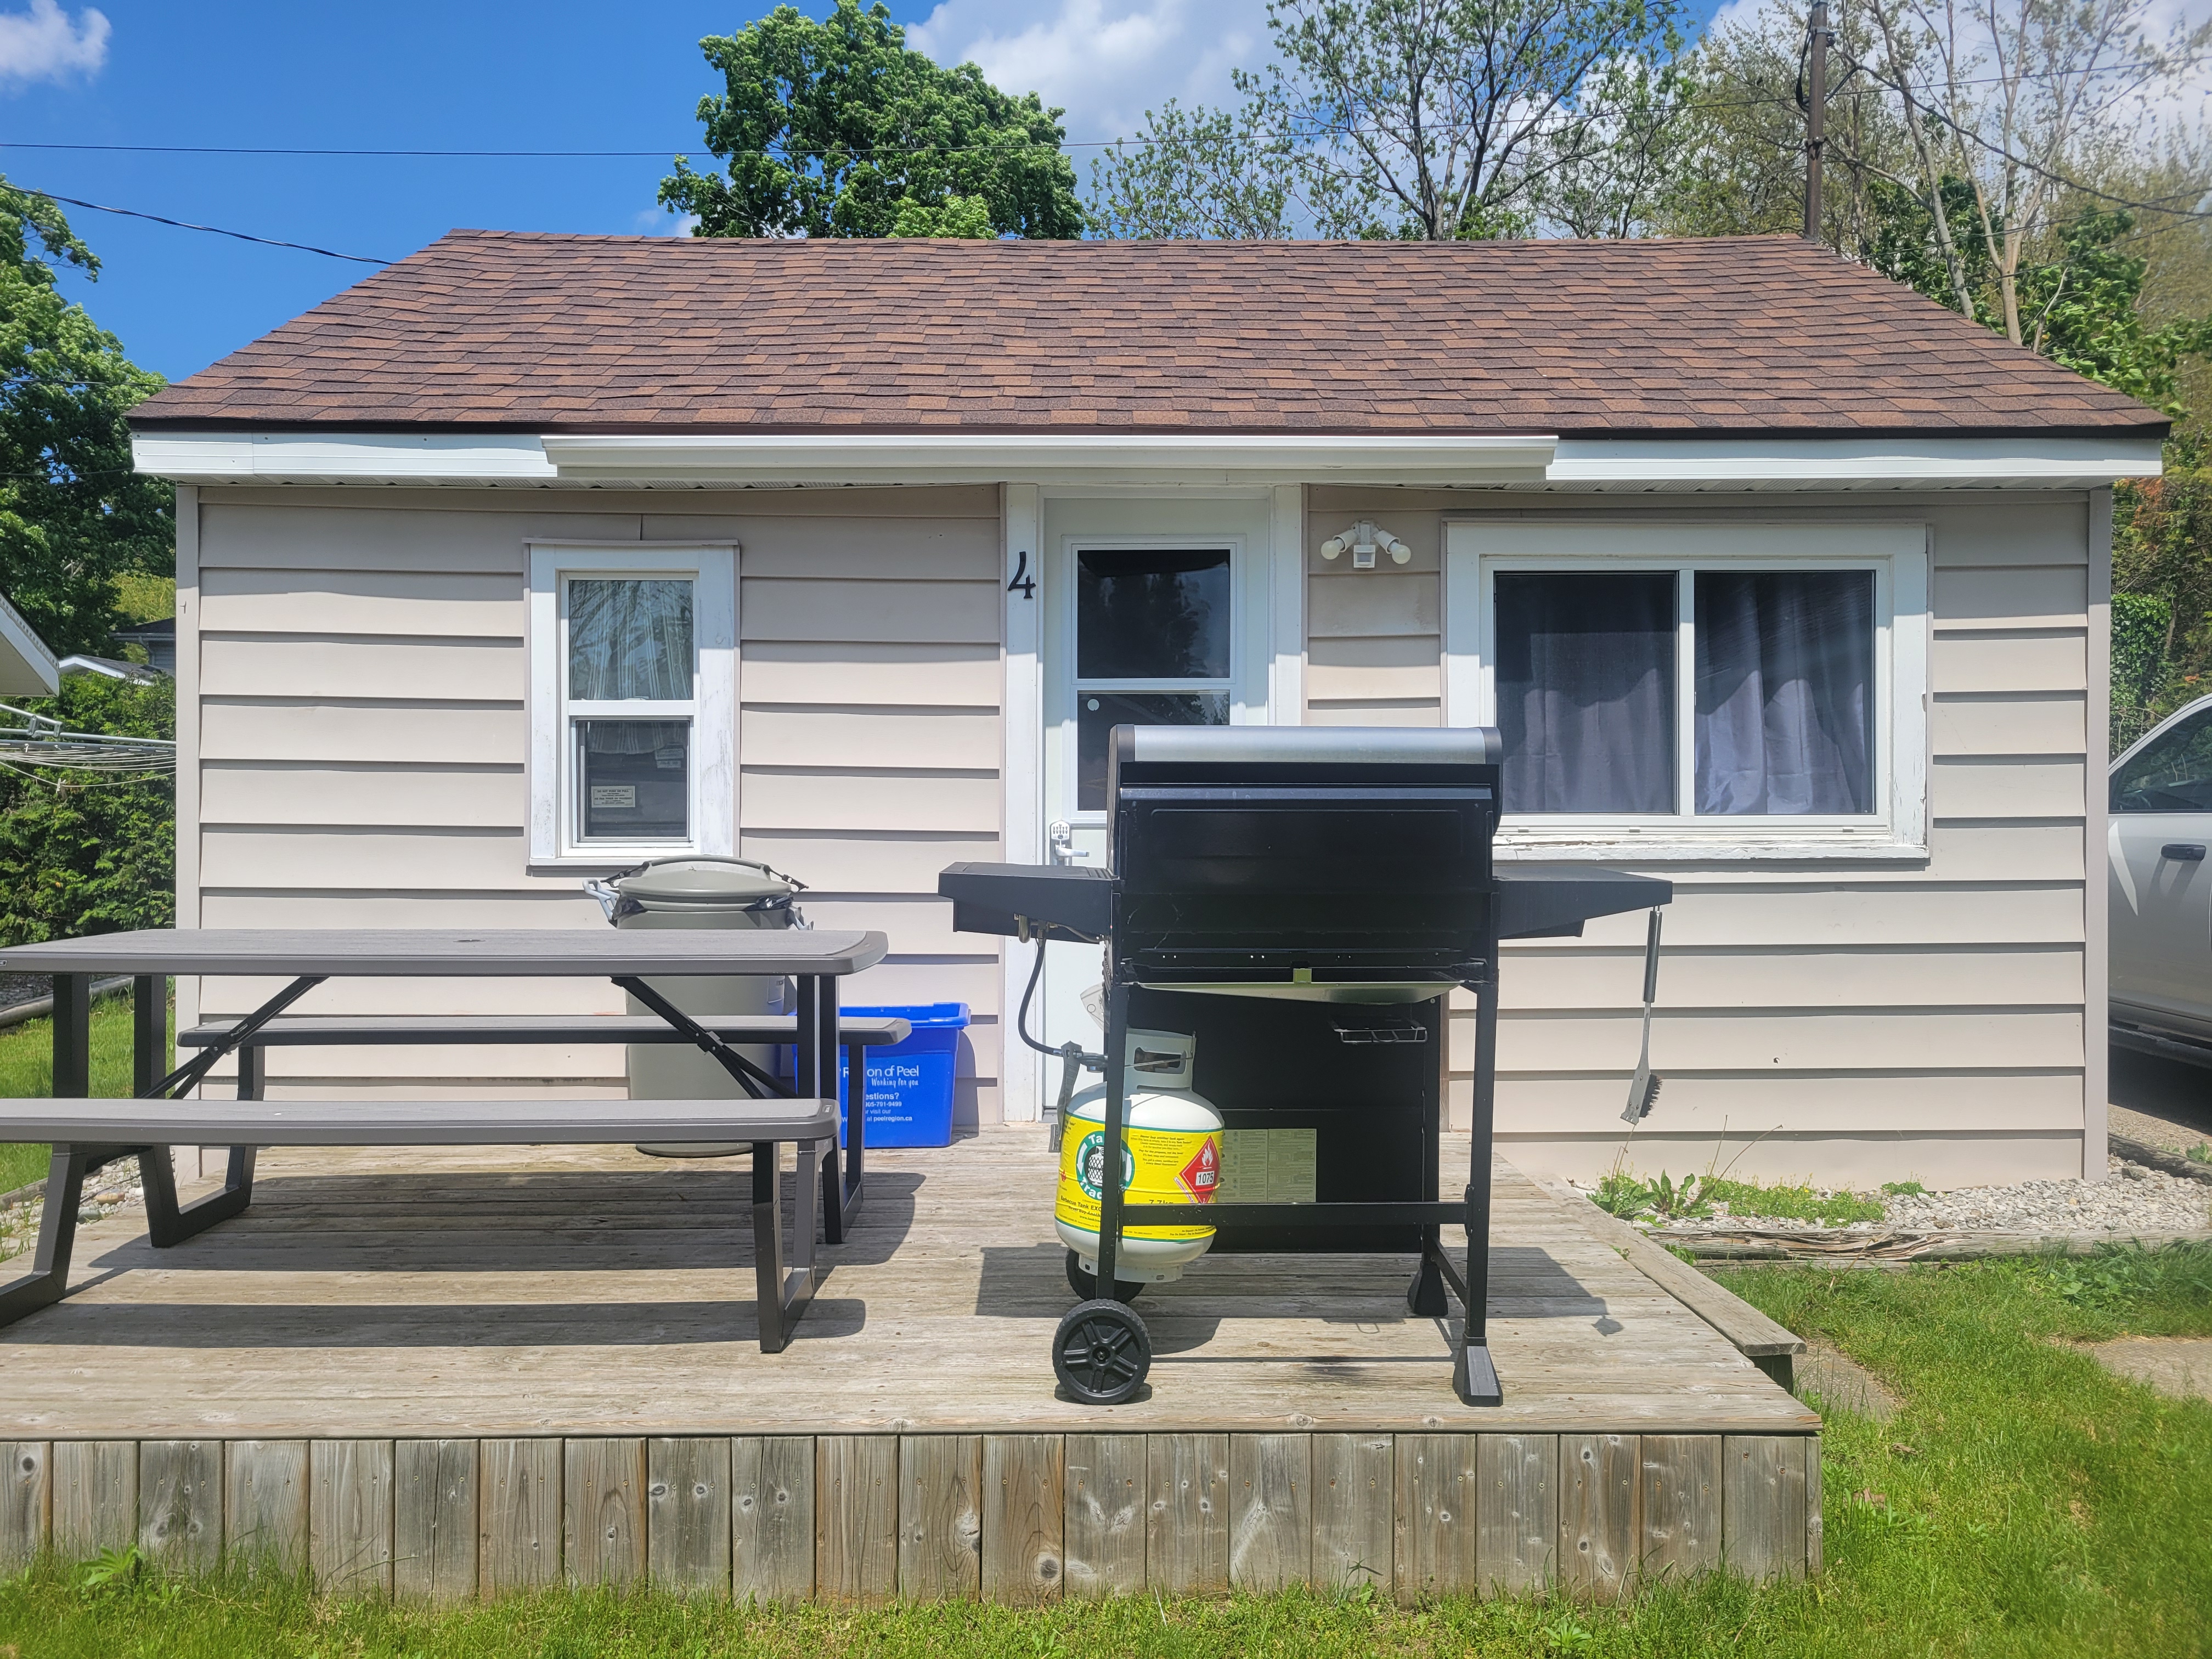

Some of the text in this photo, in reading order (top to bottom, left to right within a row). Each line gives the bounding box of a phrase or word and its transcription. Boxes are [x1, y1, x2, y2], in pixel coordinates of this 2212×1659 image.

[1007, 551, 1036, 599] 4
[884, 1065, 895, 1077] of
[896, 1065, 919, 1076] Peel
[871, 1077, 919, 1088] Working for you
[1088, 1133, 1103, 1145] Ta
[1198, 1172, 1214, 1184] 1075
